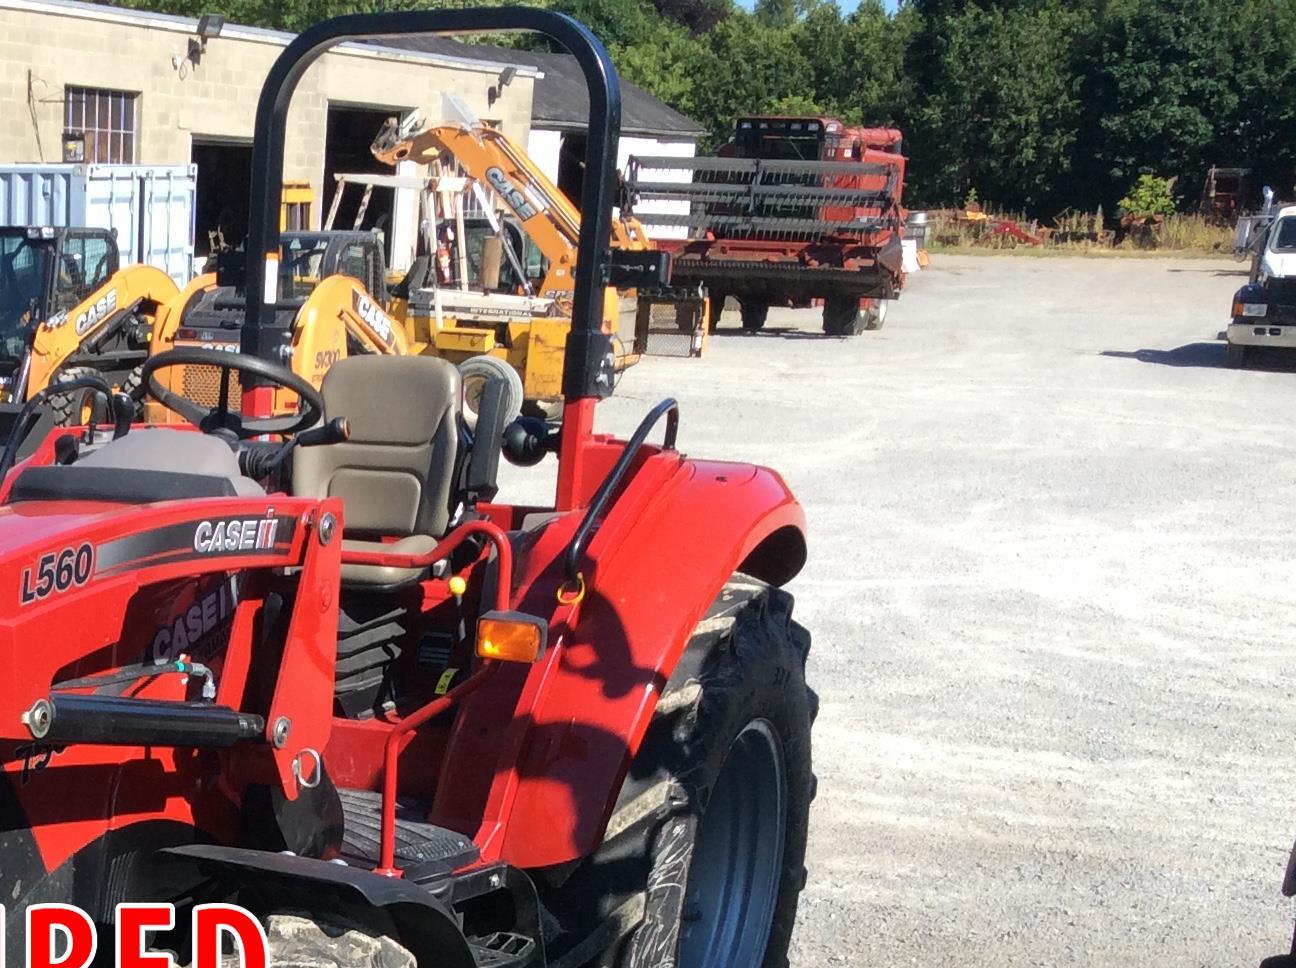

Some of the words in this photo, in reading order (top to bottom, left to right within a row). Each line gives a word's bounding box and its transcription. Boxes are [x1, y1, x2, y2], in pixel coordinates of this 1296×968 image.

[486, 166, 538, 222] CASE
[76, 288, 117, 336] CASE
[357, 294, 392, 341] CASE
[20, 541, 95, 606] L560
